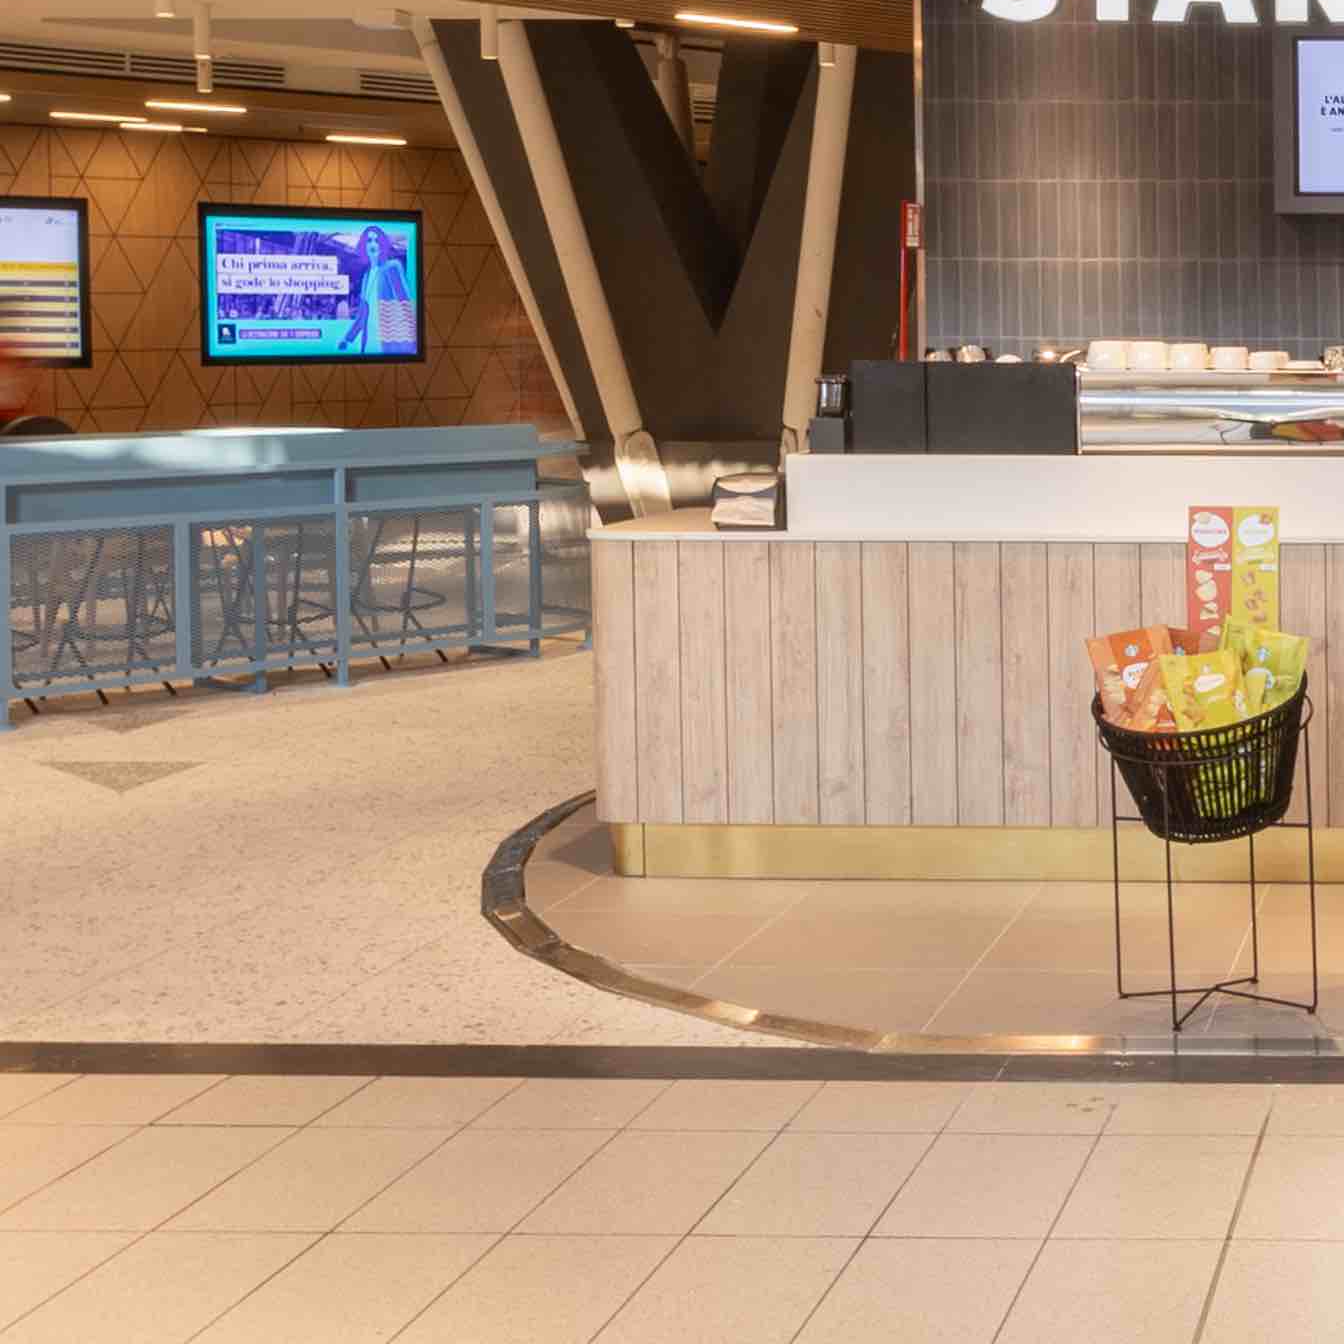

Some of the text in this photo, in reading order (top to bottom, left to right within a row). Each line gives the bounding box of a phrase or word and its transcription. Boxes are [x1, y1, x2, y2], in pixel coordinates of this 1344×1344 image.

[221, 257, 244, 270] Chi
[248, 258, 289, 273] prima
[221, 276, 232, 288] si
[235, 276, 267, 289] gode
[269, 276, 282, 288] lo
